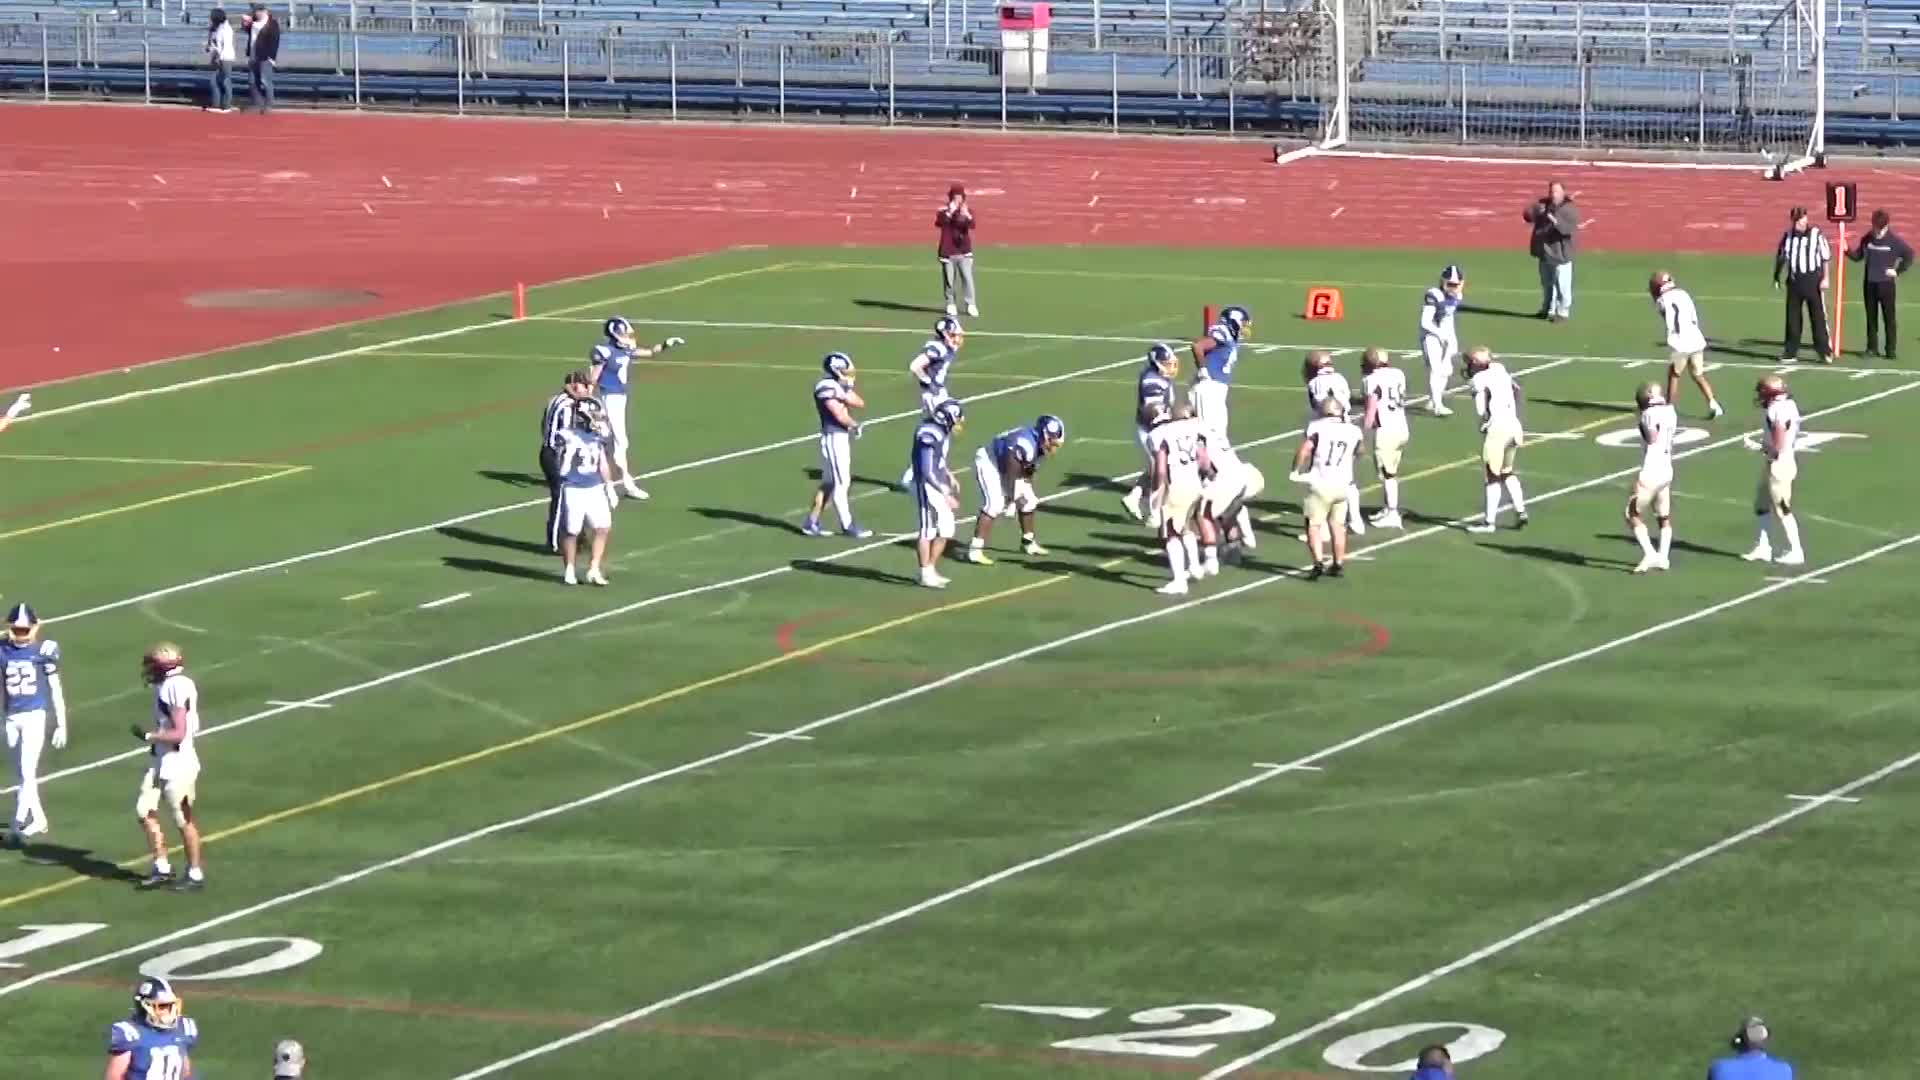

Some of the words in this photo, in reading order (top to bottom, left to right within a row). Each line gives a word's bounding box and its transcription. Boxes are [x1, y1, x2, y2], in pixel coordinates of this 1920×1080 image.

[1834, 186, 1846, 215] 1
[1313, 293, 1331, 316] G
[1325, 440, 1347, 466] 17
[5, 660, 38, 696] 22
